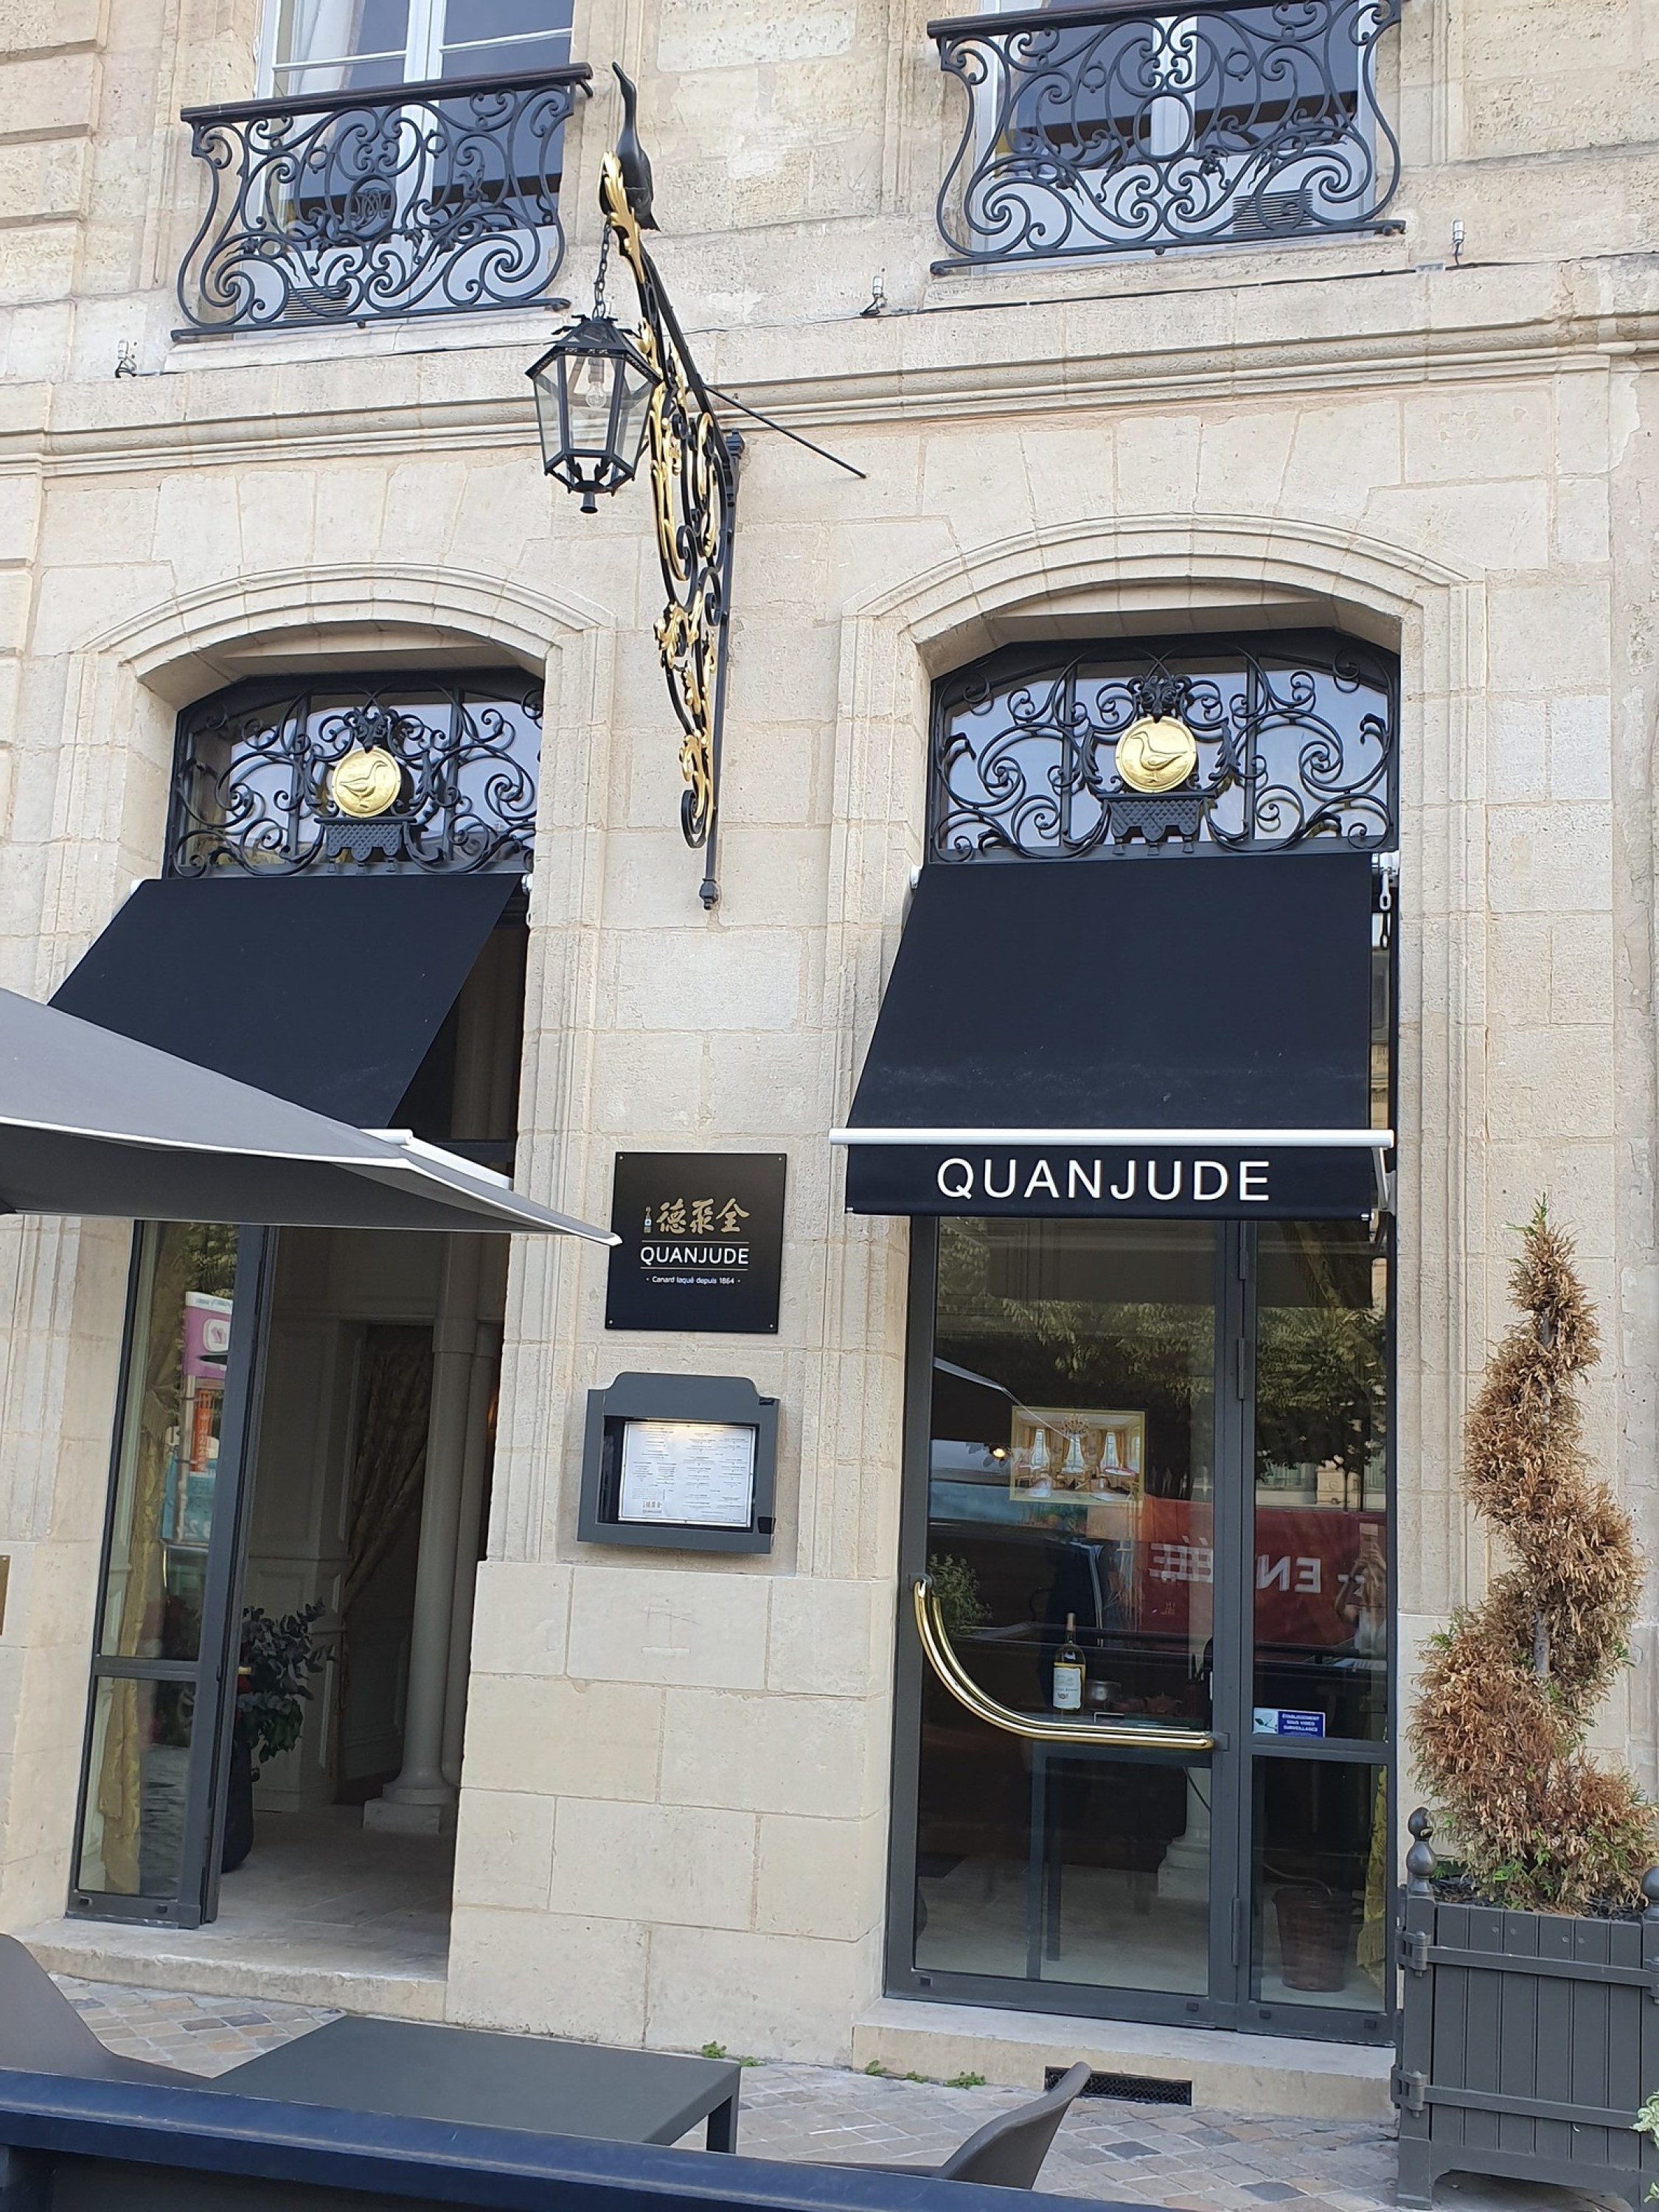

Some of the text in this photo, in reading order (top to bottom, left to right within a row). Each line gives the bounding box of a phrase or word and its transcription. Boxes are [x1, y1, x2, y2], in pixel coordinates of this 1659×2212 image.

[937, 1157, 1270, 1202] QUANJUDE
[640, 1246, 749, 1266] QUANJUDE
[652, 1276, 675, 1284] Canard
[676, 1276, 695, 1285] laqué
[696, 1277, 717, 1285] depuis
